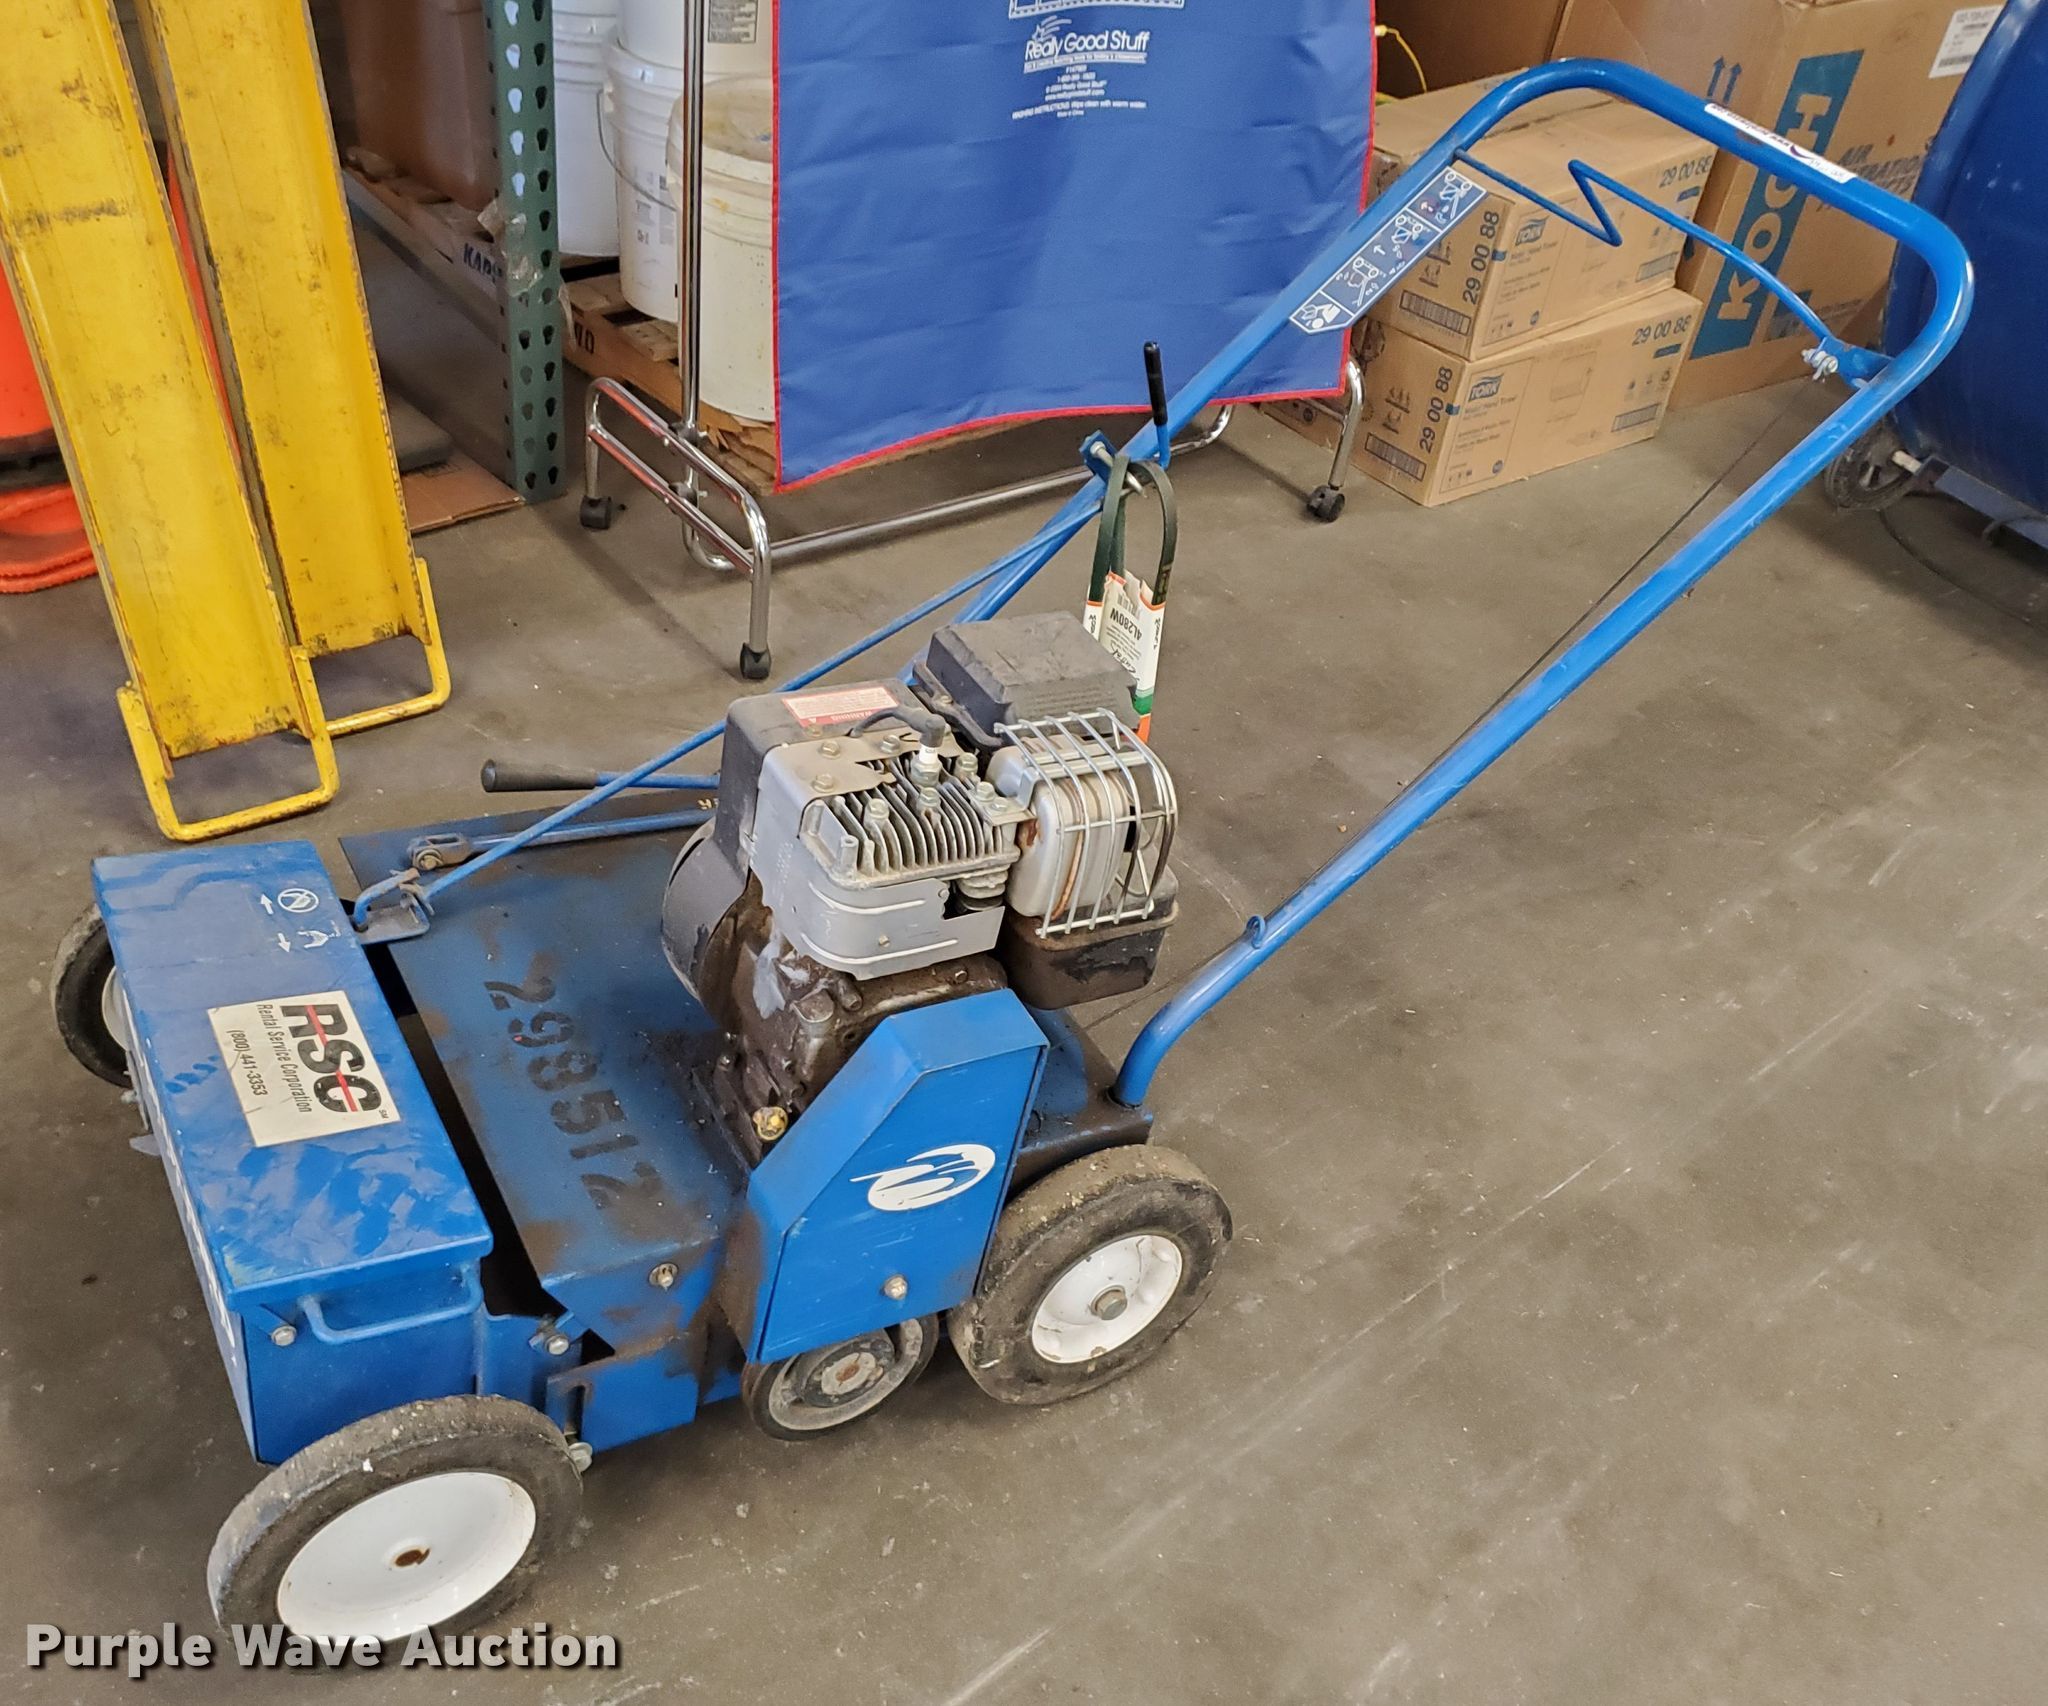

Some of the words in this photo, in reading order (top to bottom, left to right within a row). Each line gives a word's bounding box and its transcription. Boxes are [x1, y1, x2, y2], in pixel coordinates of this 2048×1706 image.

[1064, 30, 1108, 53] Good
[1110, 29, 1150, 51] Stuff
[1659, 166, 1677, 188] 29
[1679, 160, 1695, 181] 00
[1717, 94, 1832, 320] KOCH
[1480, 211, 1499, 239] 88
[1471, 244, 1490, 272] 00
[1462, 277, 1481, 305] 29
[1632, 326, 1651, 346] 29
[1654, 320, 1672, 340] 00
[1435, 366, 1453, 393] 88
[1470, 382, 1499, 400] TORK
[1427, 397, 1444, 422] 00
[1419, 427, 1436, 454] 29
[1110, 607, 1143, 641] 4L280W
[226, 1029, 252, 1053] (800)
[240, 1053, 268, 1097] 441-3353
[256, 1004, 277, 1030] Rental
[267, 1030, 291, 1062] Service
[280, 1062, 313, 1113] Corporation
[280, 1003, 382, 1113] RSC
